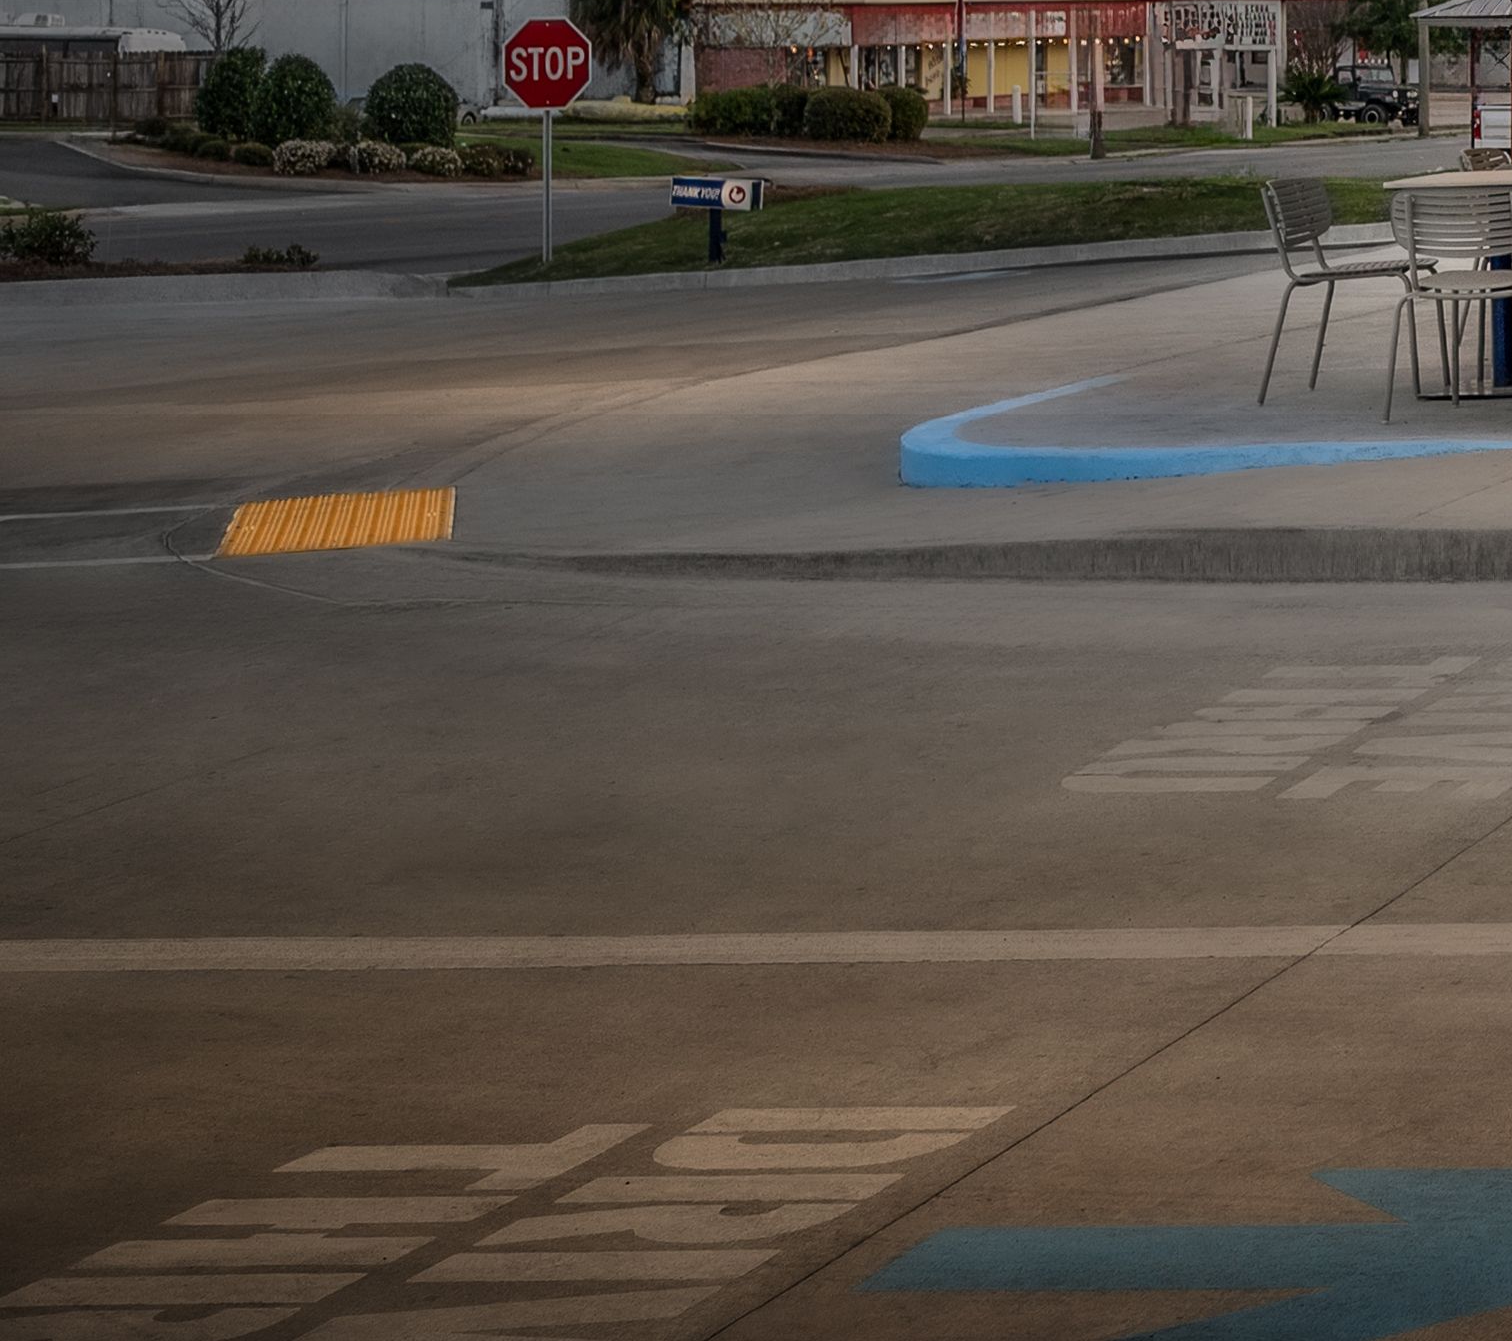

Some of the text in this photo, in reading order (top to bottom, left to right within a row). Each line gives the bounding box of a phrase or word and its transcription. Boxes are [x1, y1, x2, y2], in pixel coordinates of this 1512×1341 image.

[509, 46, 585, 82] STOP
[672, 184, 701, 198] THANK
[1061, 655, 1482, 793] THRU
